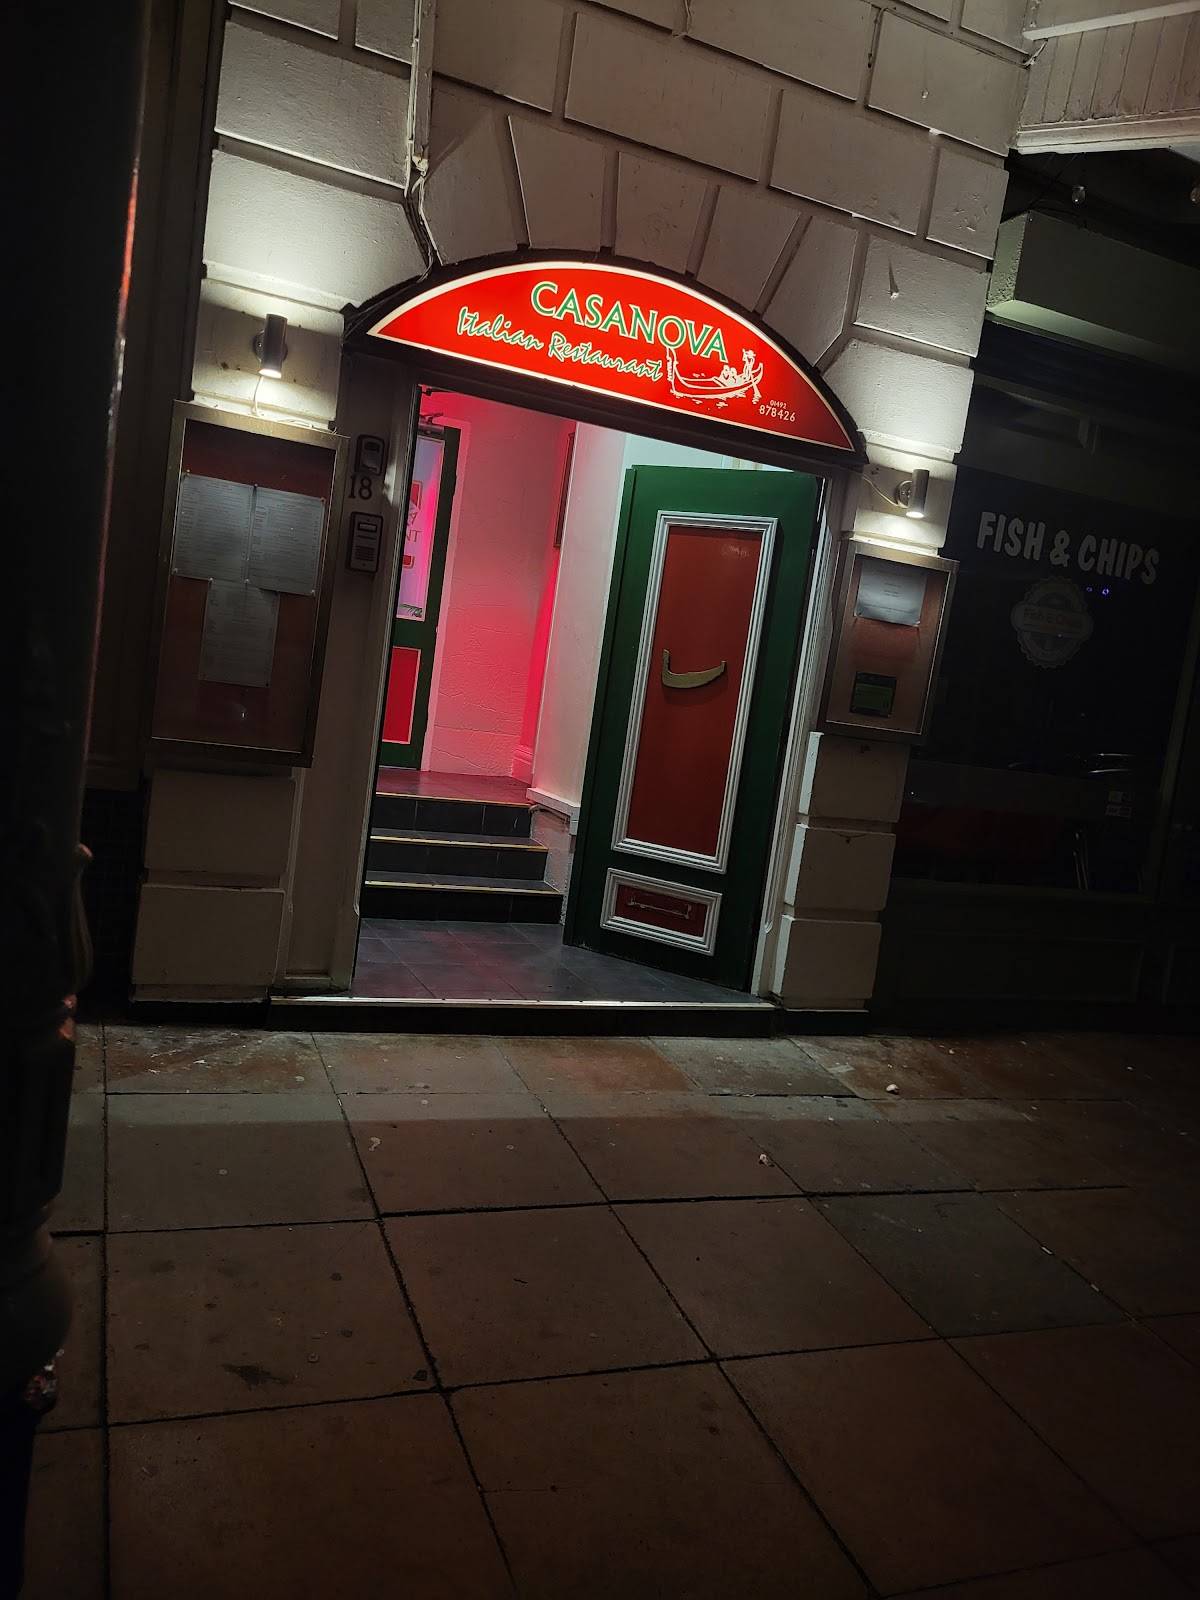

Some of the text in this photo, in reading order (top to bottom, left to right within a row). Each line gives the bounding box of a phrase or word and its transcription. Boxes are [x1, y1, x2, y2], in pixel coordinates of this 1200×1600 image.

[456, 306, 663, 382] Italian Restaurant
[531, 281, 728, 363] CASANOVA
[759, 404, 796, 422] 878426
[349, 476, 372, 500] 18
[977, 511, 1160, 585] FISH & CHIPS
